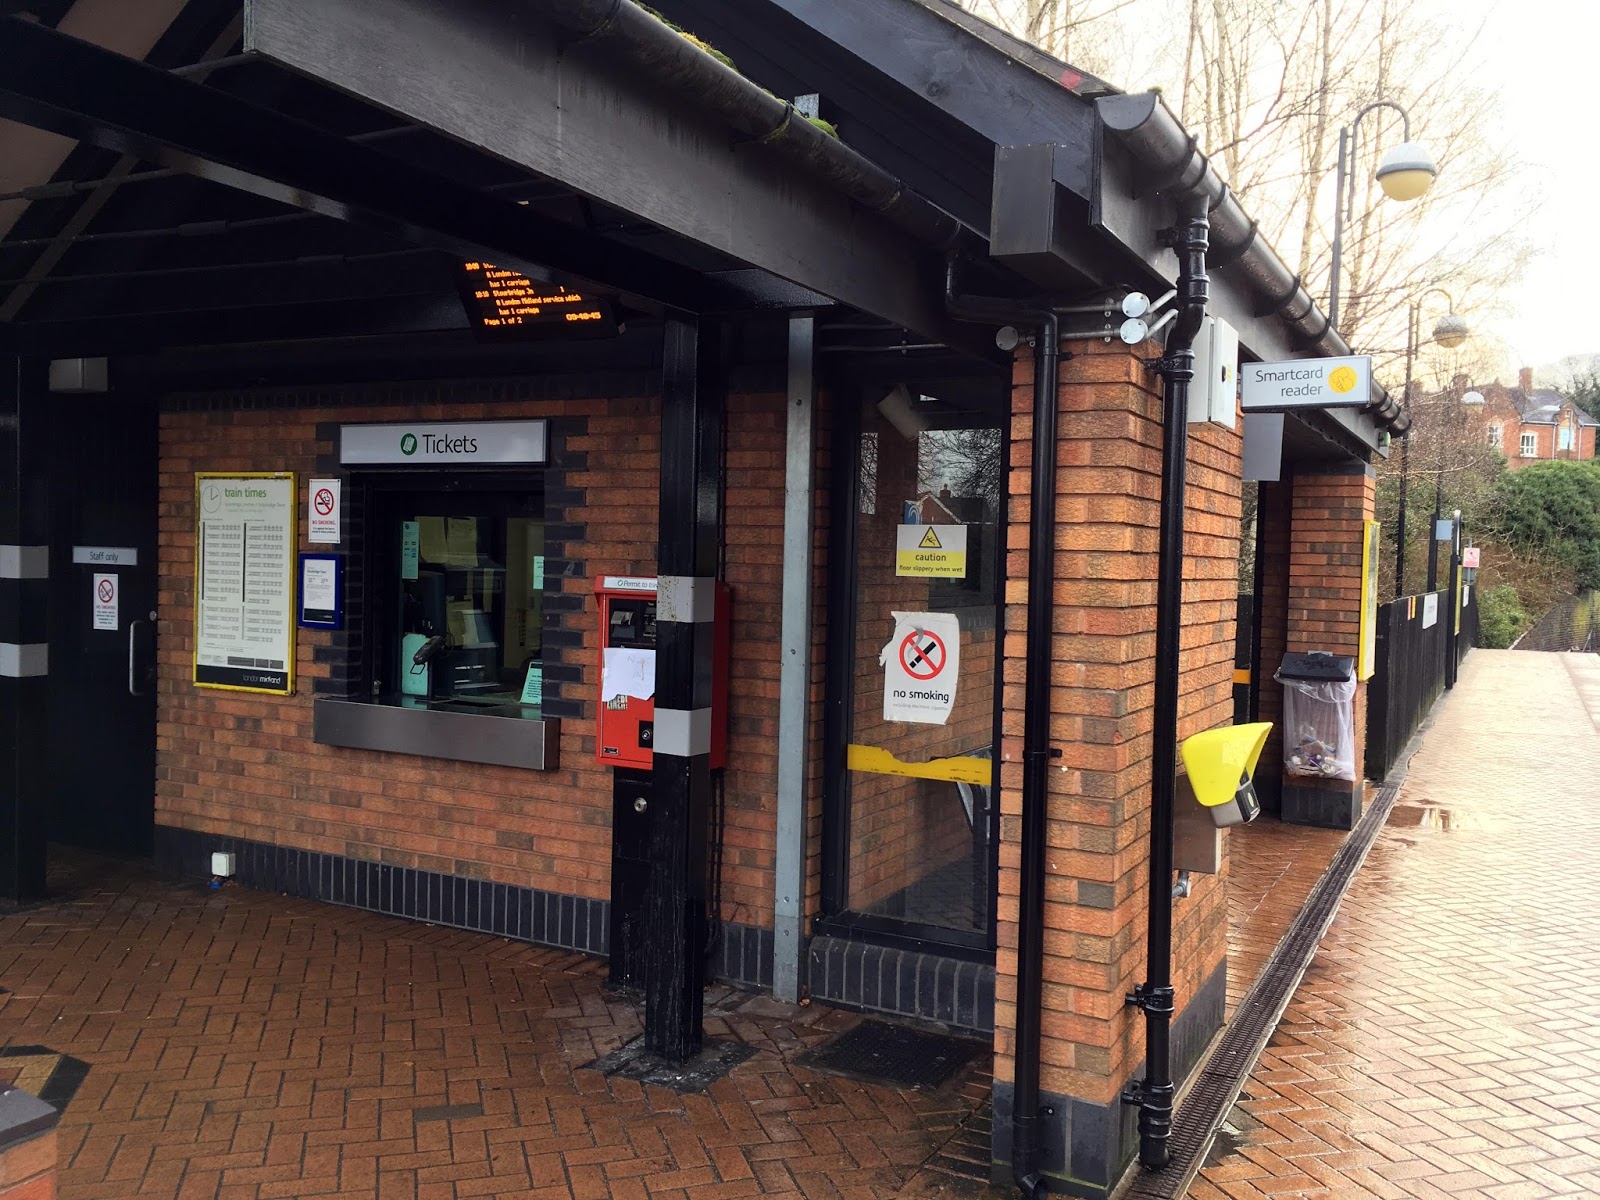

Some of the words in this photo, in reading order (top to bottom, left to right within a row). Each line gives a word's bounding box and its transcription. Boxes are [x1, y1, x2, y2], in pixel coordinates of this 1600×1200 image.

[491, 270, 512, 278] London
[506, 279, 530, 287] carriage
[501, 298, 521, 306] London
[521, 296, 542, 305] Midland
[565, 294, 582, 302] which
[516, 306, 540, 315] carriage
[483, 318, 500, 326] Page
[516, 316, 523, 324] 2
[1255, 366, 1323, 383] Smartcard
[1281, 384, 1323, 397] reader
[422, 433, 478, 454] Tickets
[224, 487, 242, 498] train
[244, 486, 267, 498] times
[89, 551, 105, 561] Staff
[105, 552, 119, 563] only
[915, 553, 947, 562] caution
[912, 565, 934, 573] slippery
[623, 579, 641, 588] Permit
[259, 676, 281, 685] midland
[893, 689, 906, 698] no
[908, 690, 950, 704] smoking
